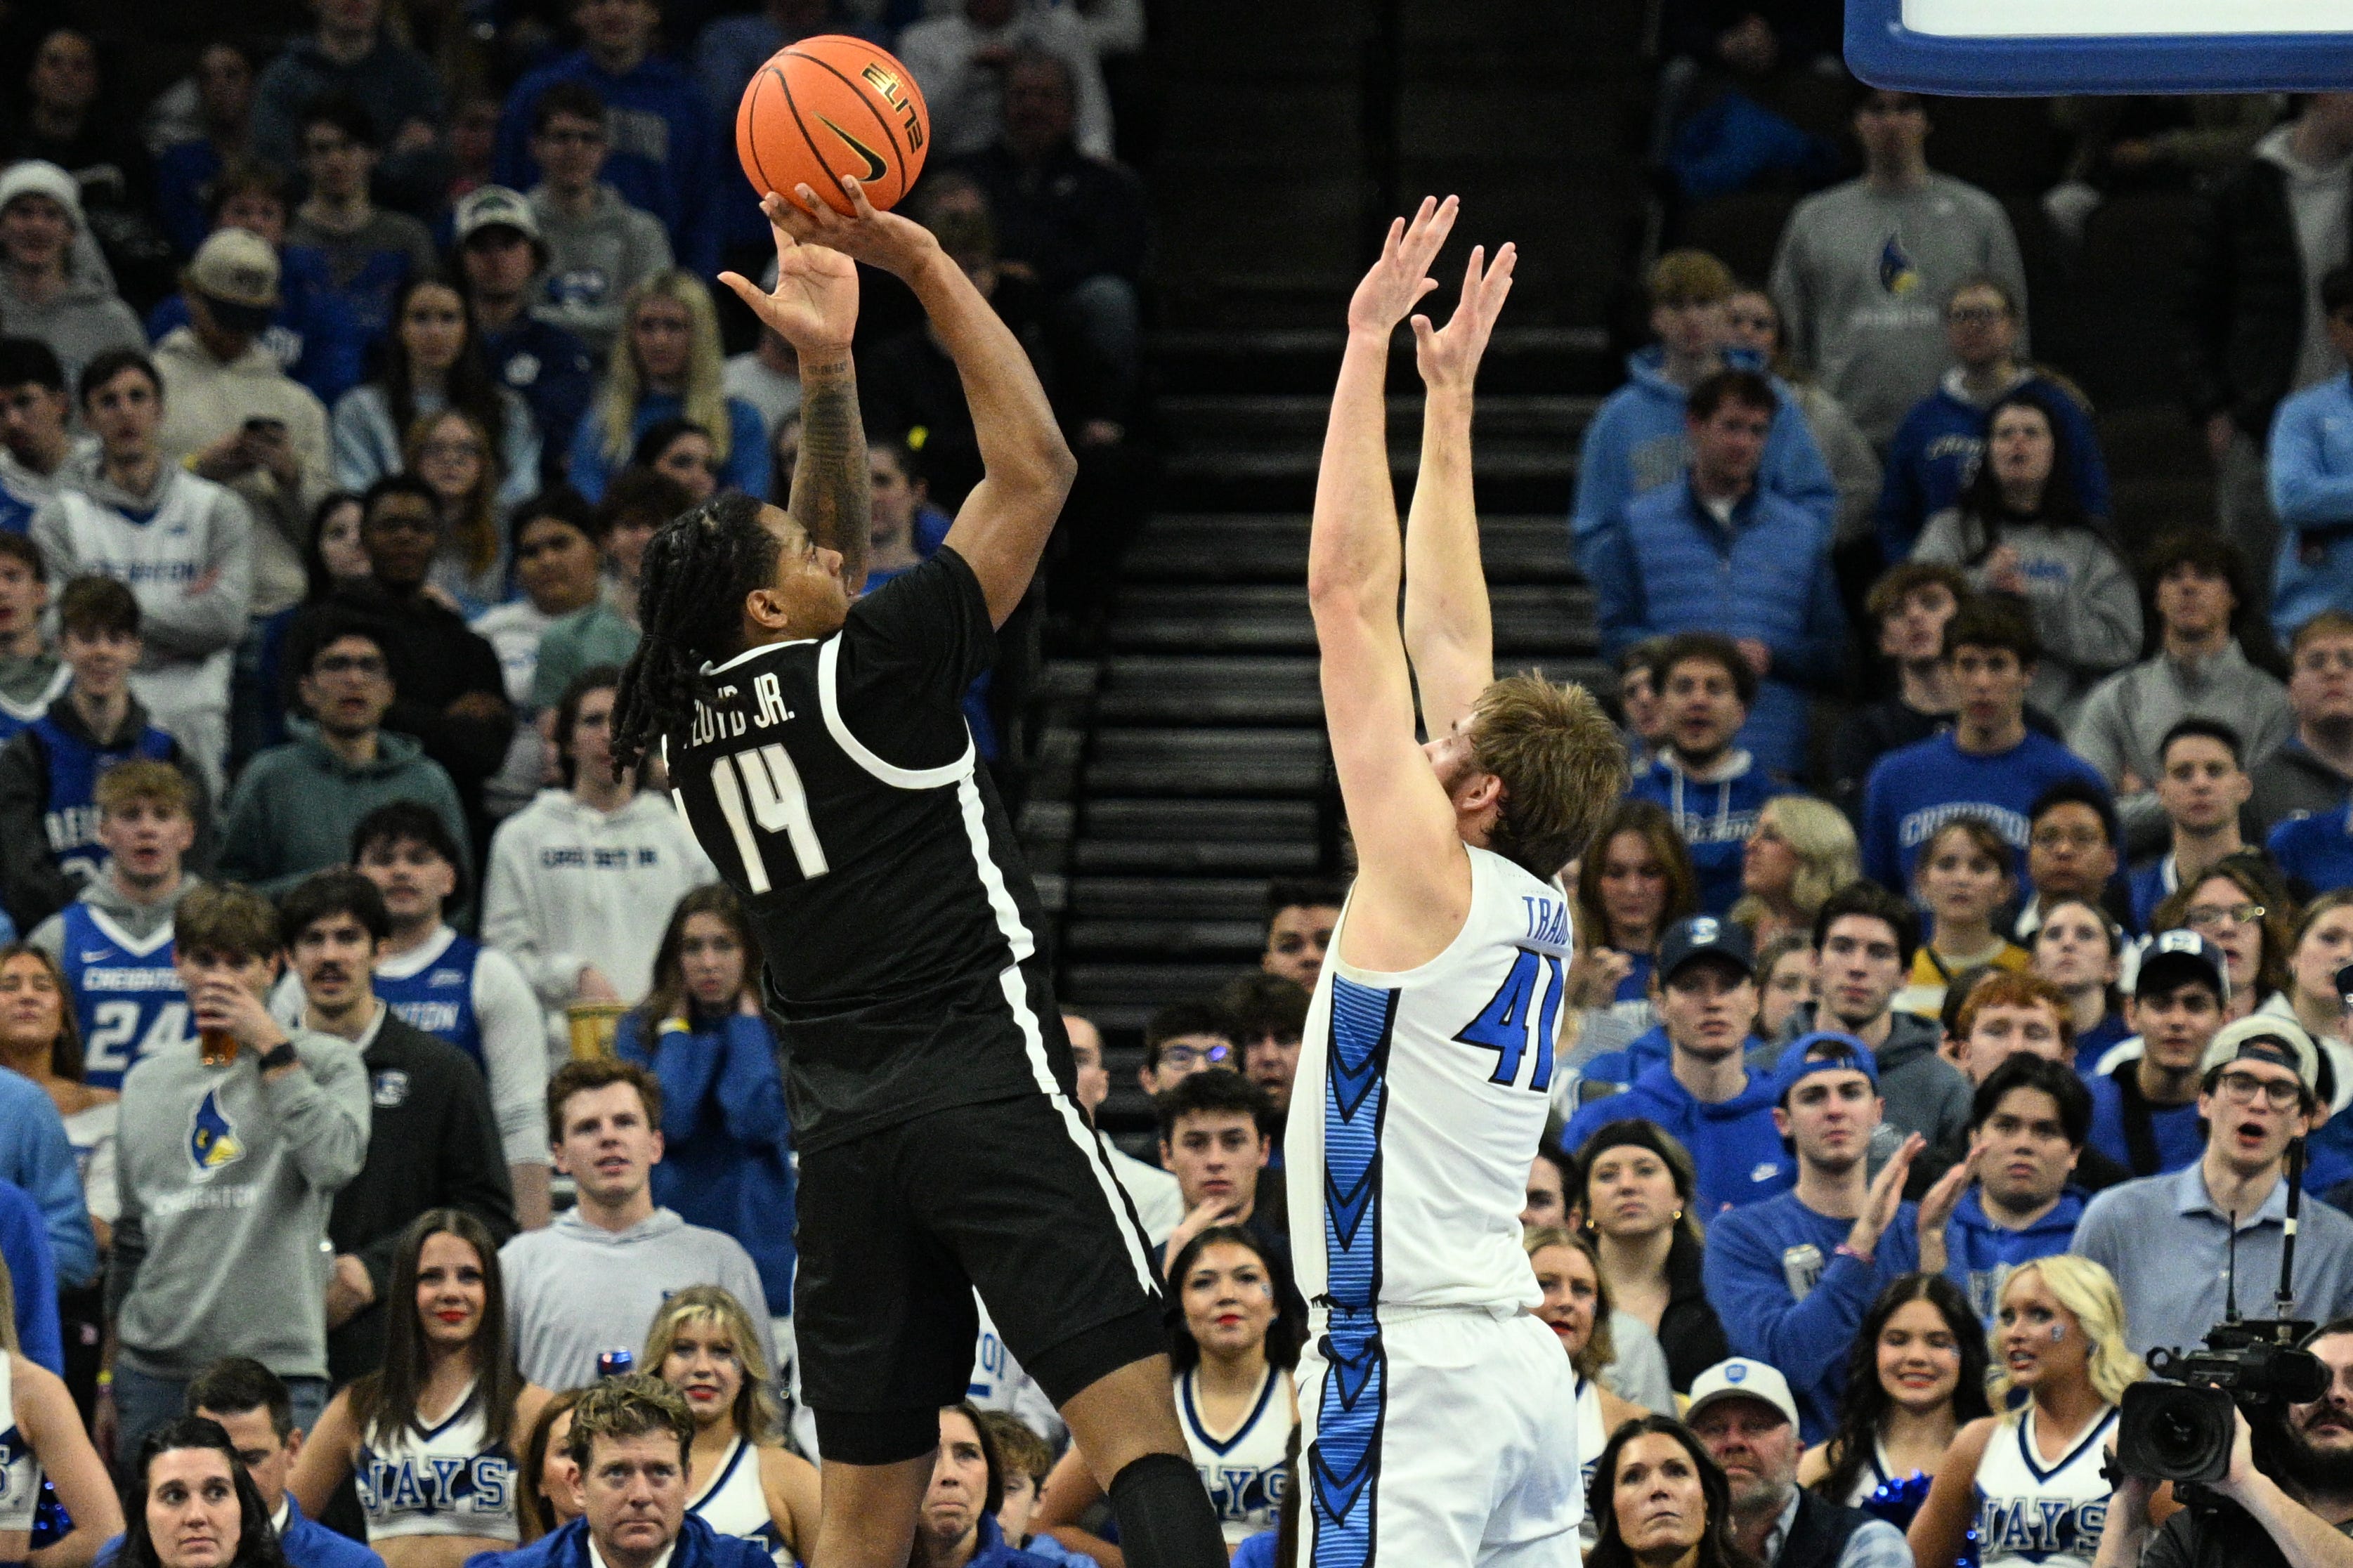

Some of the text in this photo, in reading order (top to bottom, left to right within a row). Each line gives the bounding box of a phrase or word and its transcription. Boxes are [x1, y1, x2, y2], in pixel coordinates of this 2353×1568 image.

[860, 61, 924, 155] ELITE
[753, 672, 795, 729] JR.
[710, 742, 830, 895] 14
[83, 999, 202, 1072] 24
[1450, 945, 1564, 1094] 41
[357, 1455, 509, 1517] JAYS
[1972, 1496, 2108, 1555] JAYS
